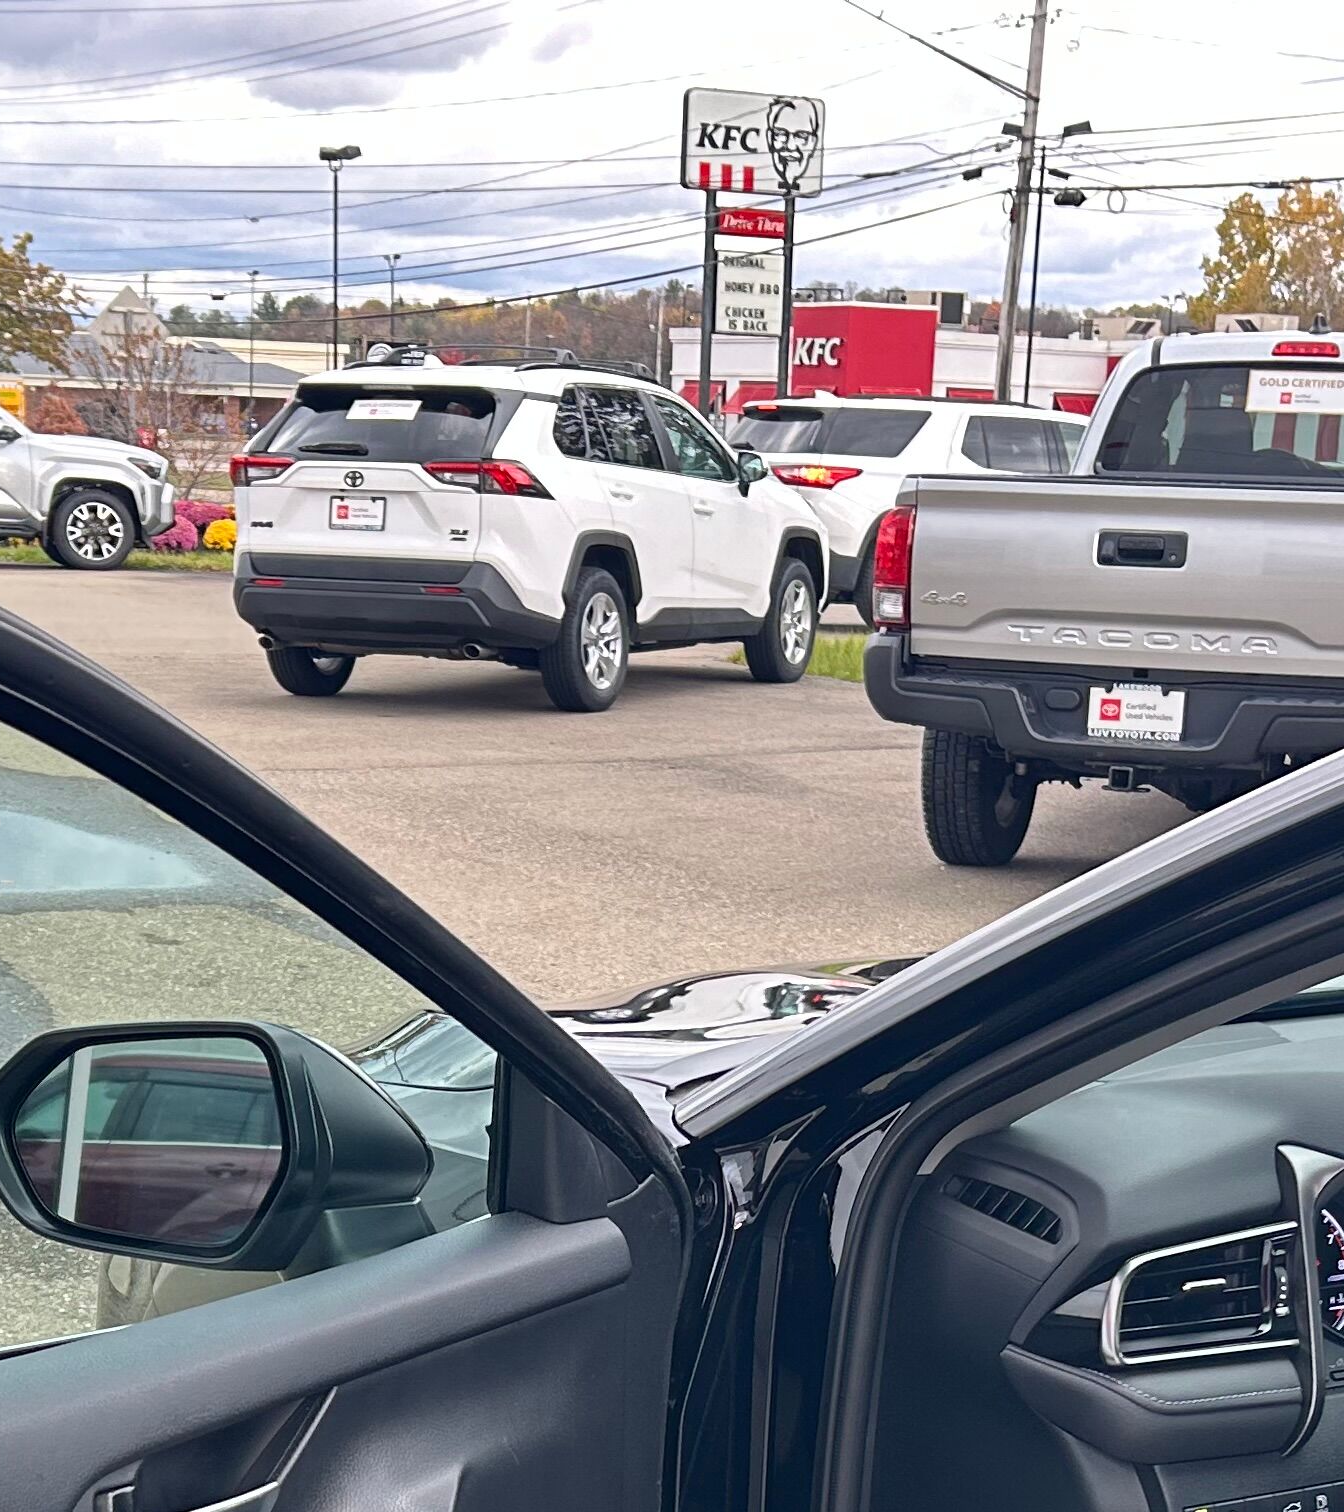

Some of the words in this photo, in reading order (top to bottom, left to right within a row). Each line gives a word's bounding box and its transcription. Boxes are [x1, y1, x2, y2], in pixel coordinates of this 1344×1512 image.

[696, 123, 760, 153] KFC
[723, 214, 753, 231] Drive
[757, 216, 785, 233] Thru
[723, 256, 765, 269] ORIGINAL
[725, 281, 754, 294] HONEY
[760, 283, 779, 295] BBQ
[725, 306, 765, 319] CHICKEN
[728, 320, 737, 330] IS
[743, 321, 768, 331] BACK
[793, 337, 841, 366] KFC
[1260, 377, 1289, 387] GOLD
[1292, 378, 1344, 389] CERTIFIED
[1006, 624, 1279, 656] TACOMA
[1126, 703, 1157, 711] Certified
[1144, 713, 1173, 721] Vehicles
[1088, 728, 1180, 741] LUVTOYOTA.COM
[1327, 1234, 1335, 1245] 7
